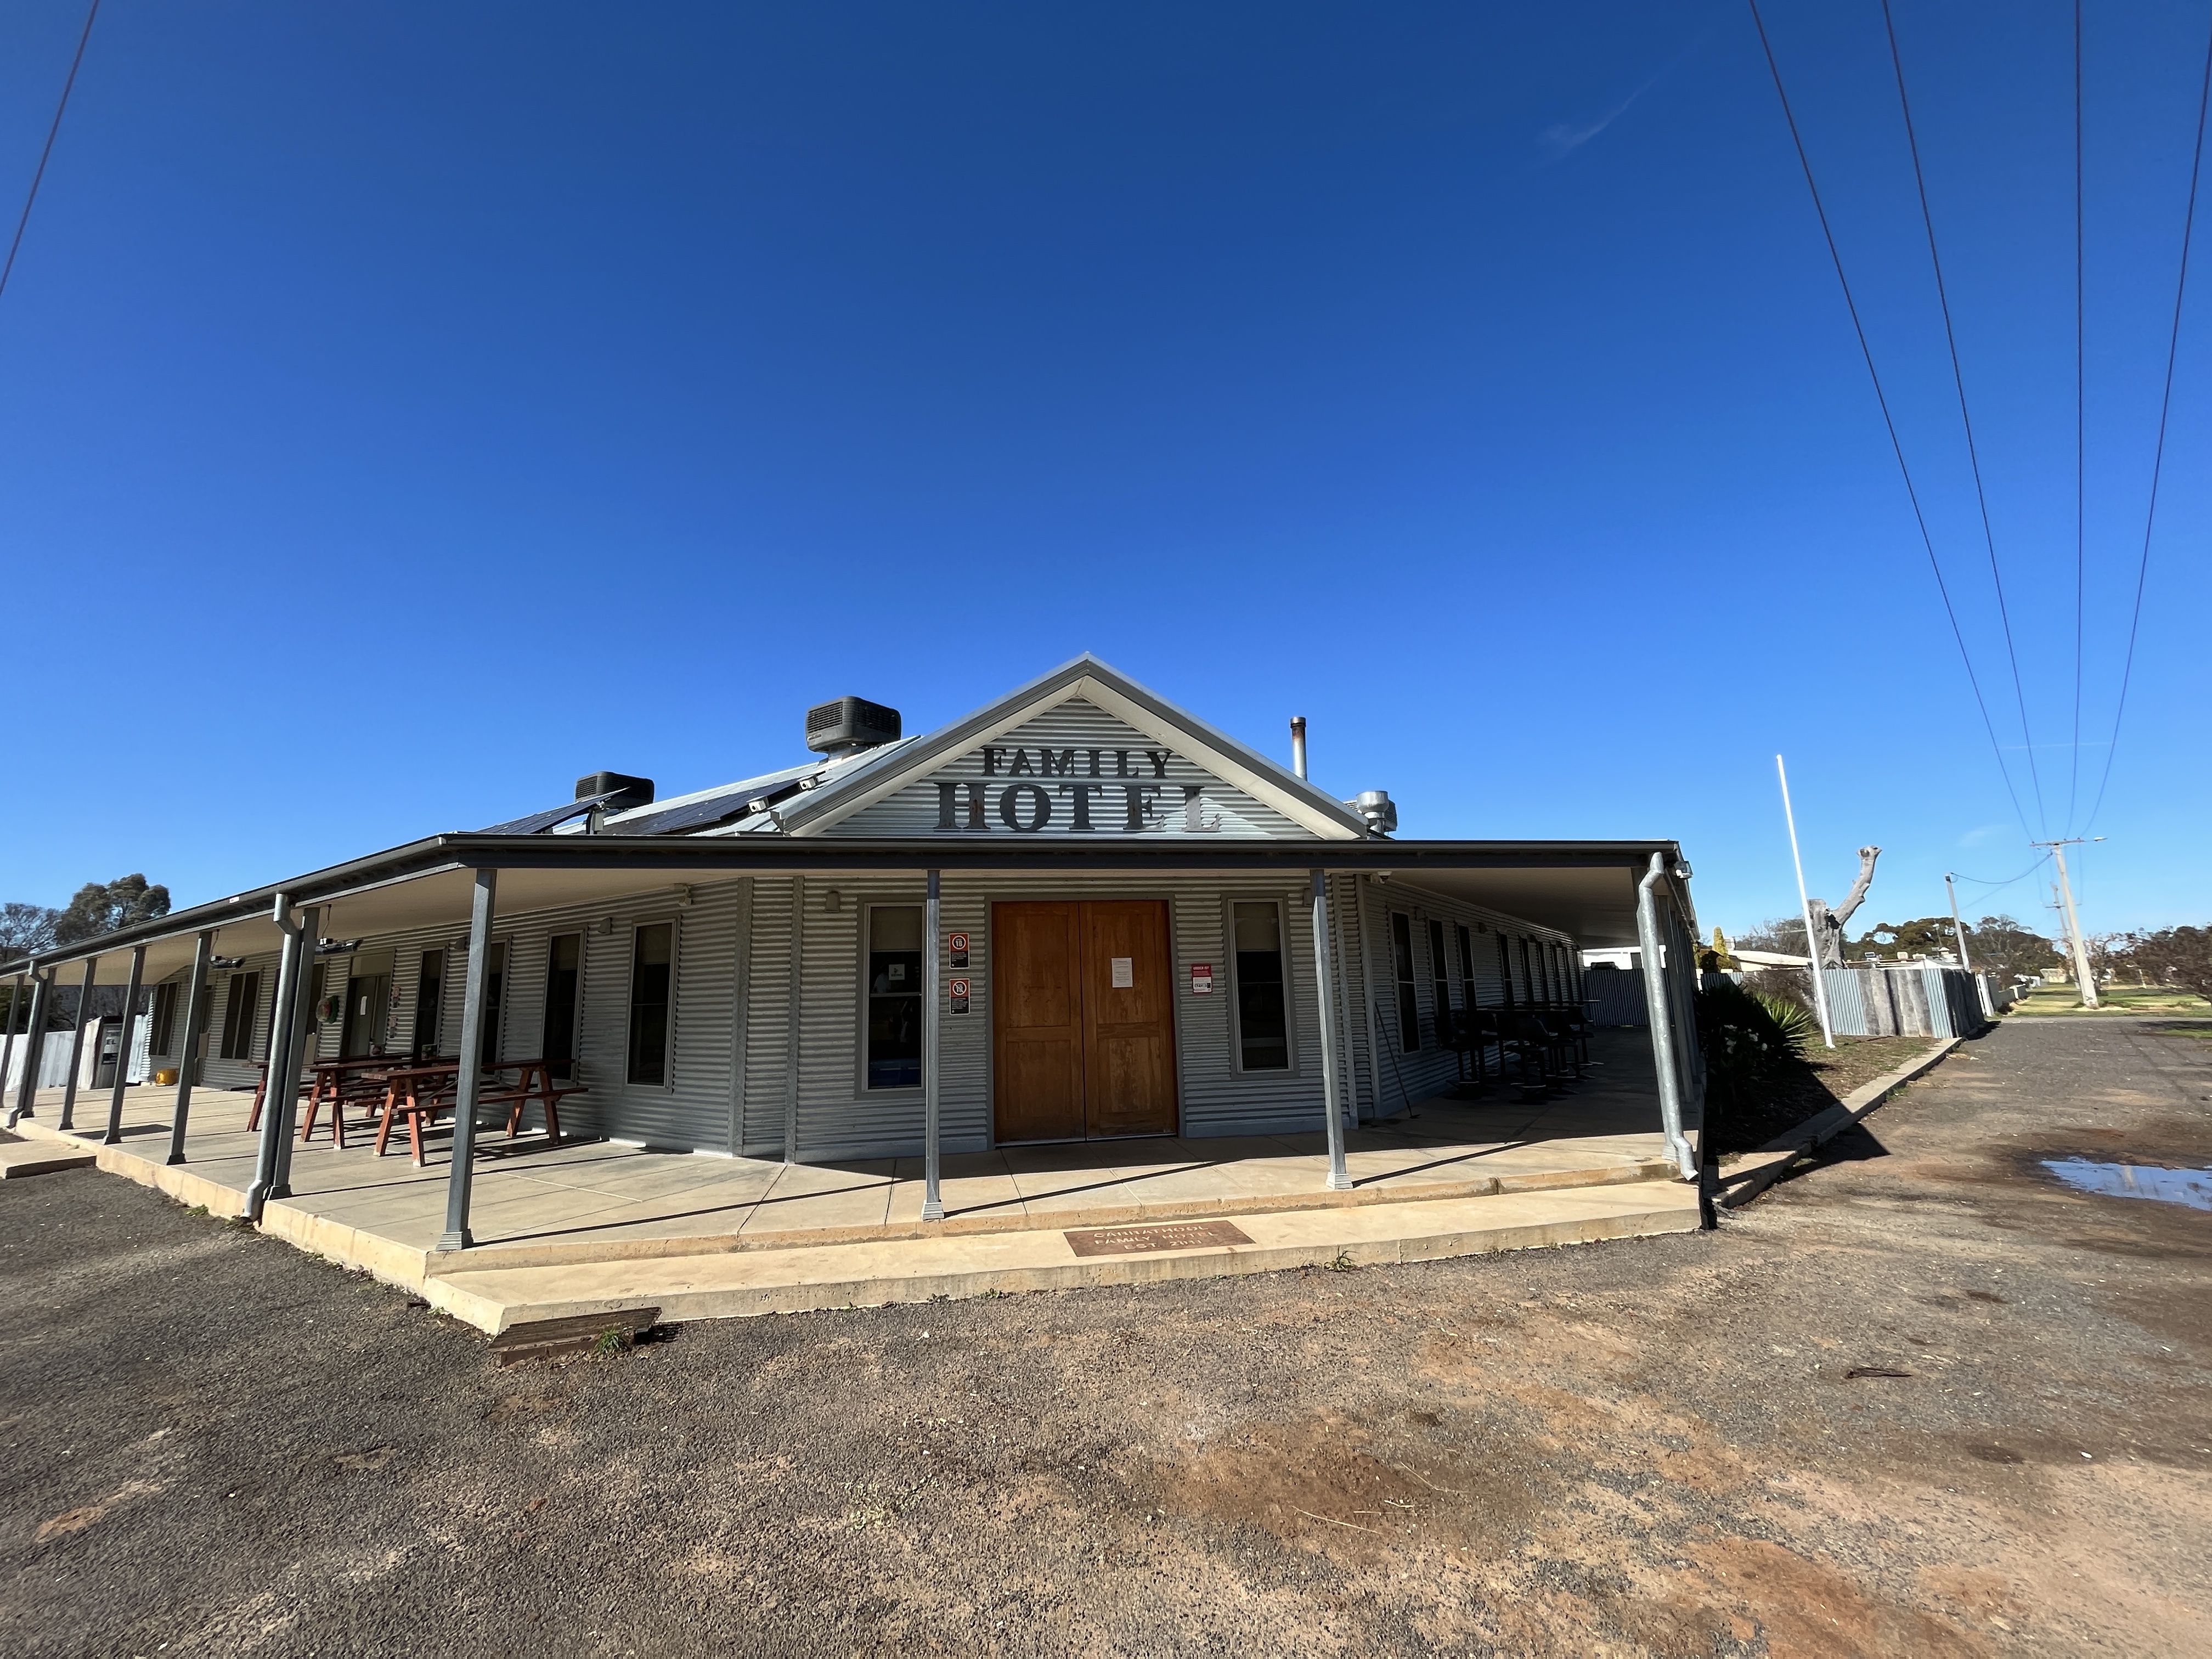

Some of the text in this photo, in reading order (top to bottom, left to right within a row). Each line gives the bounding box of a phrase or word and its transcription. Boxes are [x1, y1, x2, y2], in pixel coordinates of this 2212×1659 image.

[981, 748, 1173, 778] FAMILY
[934, 782, 1222, 833] HOTEL
[1093, 1225, 1209, 1238] CARRATHOOL
[1094, 1231, 1219, 1244] FAMILY HOTEL
